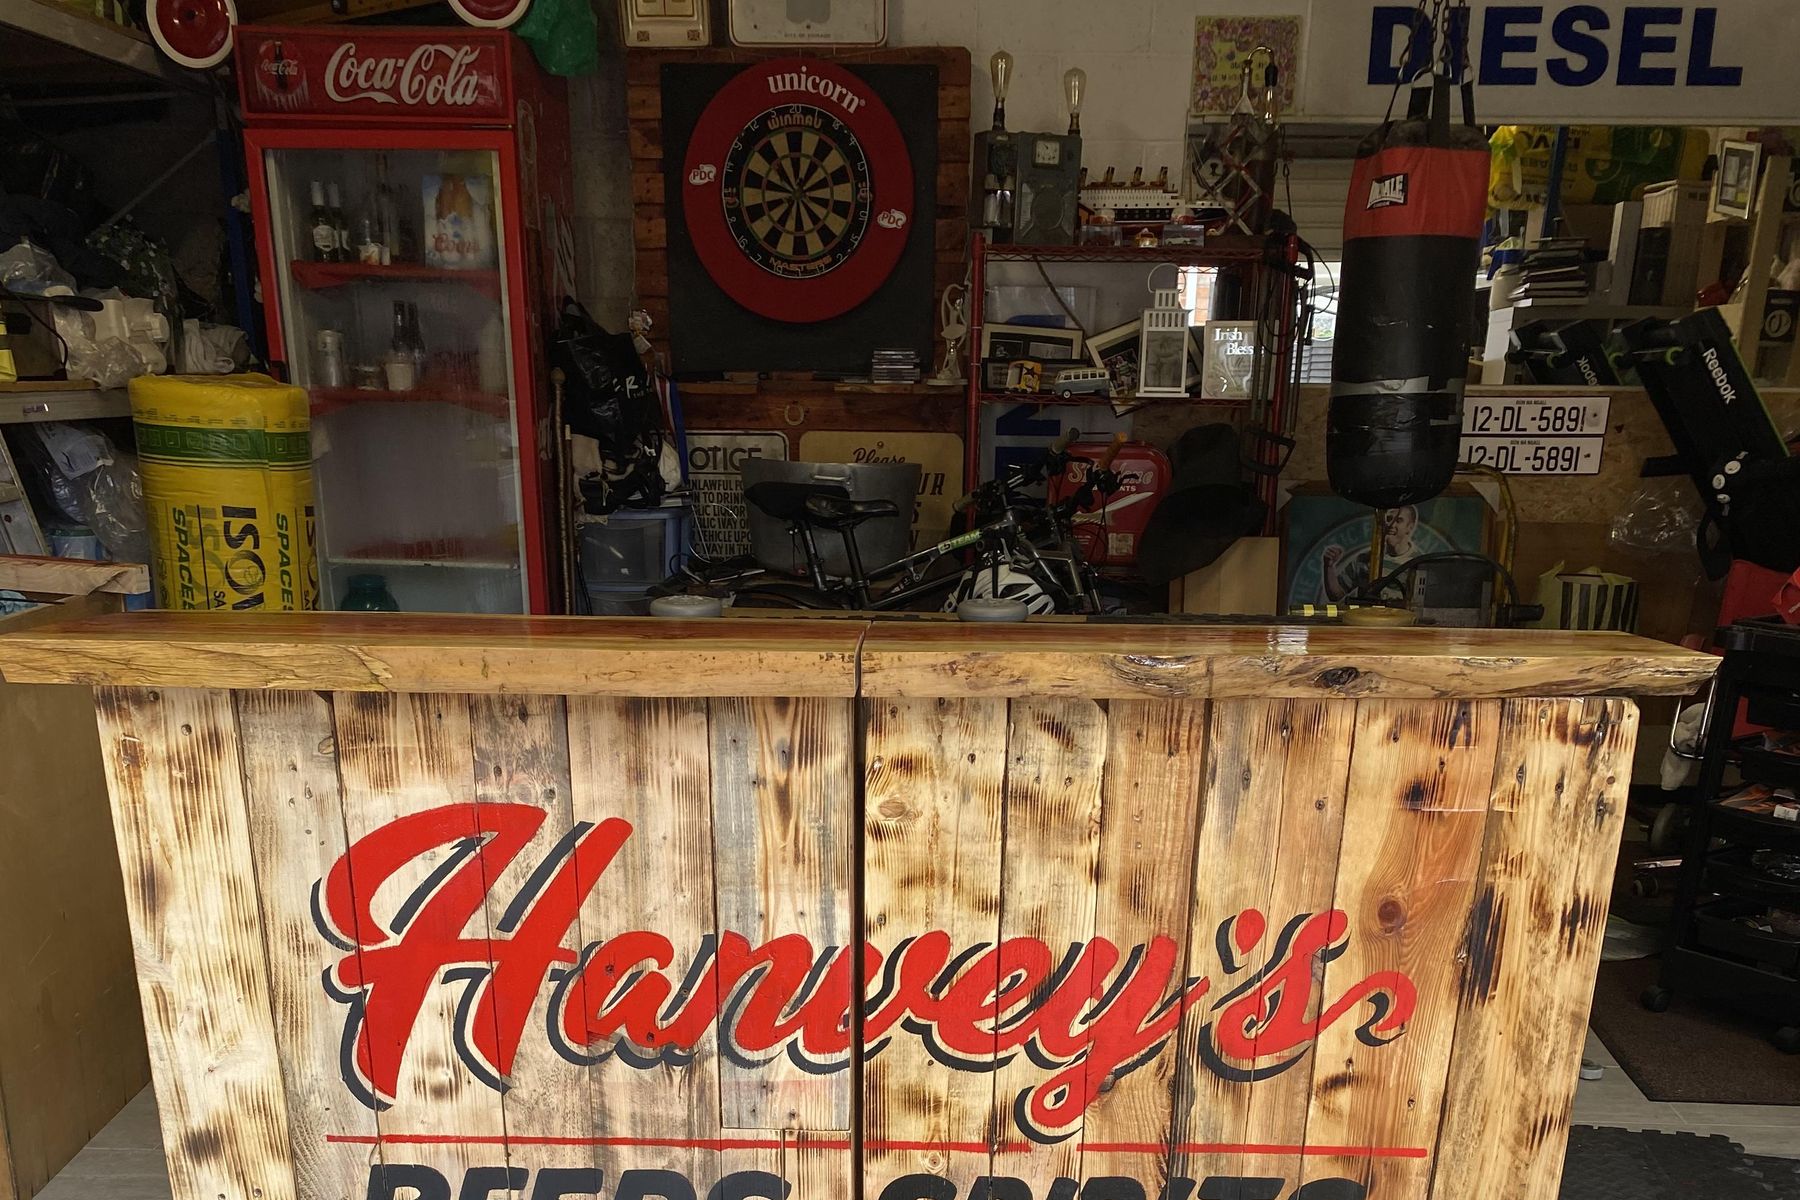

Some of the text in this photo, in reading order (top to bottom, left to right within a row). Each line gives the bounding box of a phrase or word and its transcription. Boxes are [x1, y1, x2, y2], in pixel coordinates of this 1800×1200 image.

[1368, 7, 1743, 86] DIESEL
[325, 42, 480, 106] Coca-Cola
[767, 66, 862, 114] unicorn
[692, 170, 715, 182] PDC
[880, 213, 904, 228] PDC
[1214, 327, 1243, 341] Irish
[1702, 346, 1737, 405] Reebok
[311, 803, 1417, 1143] Harvey's
